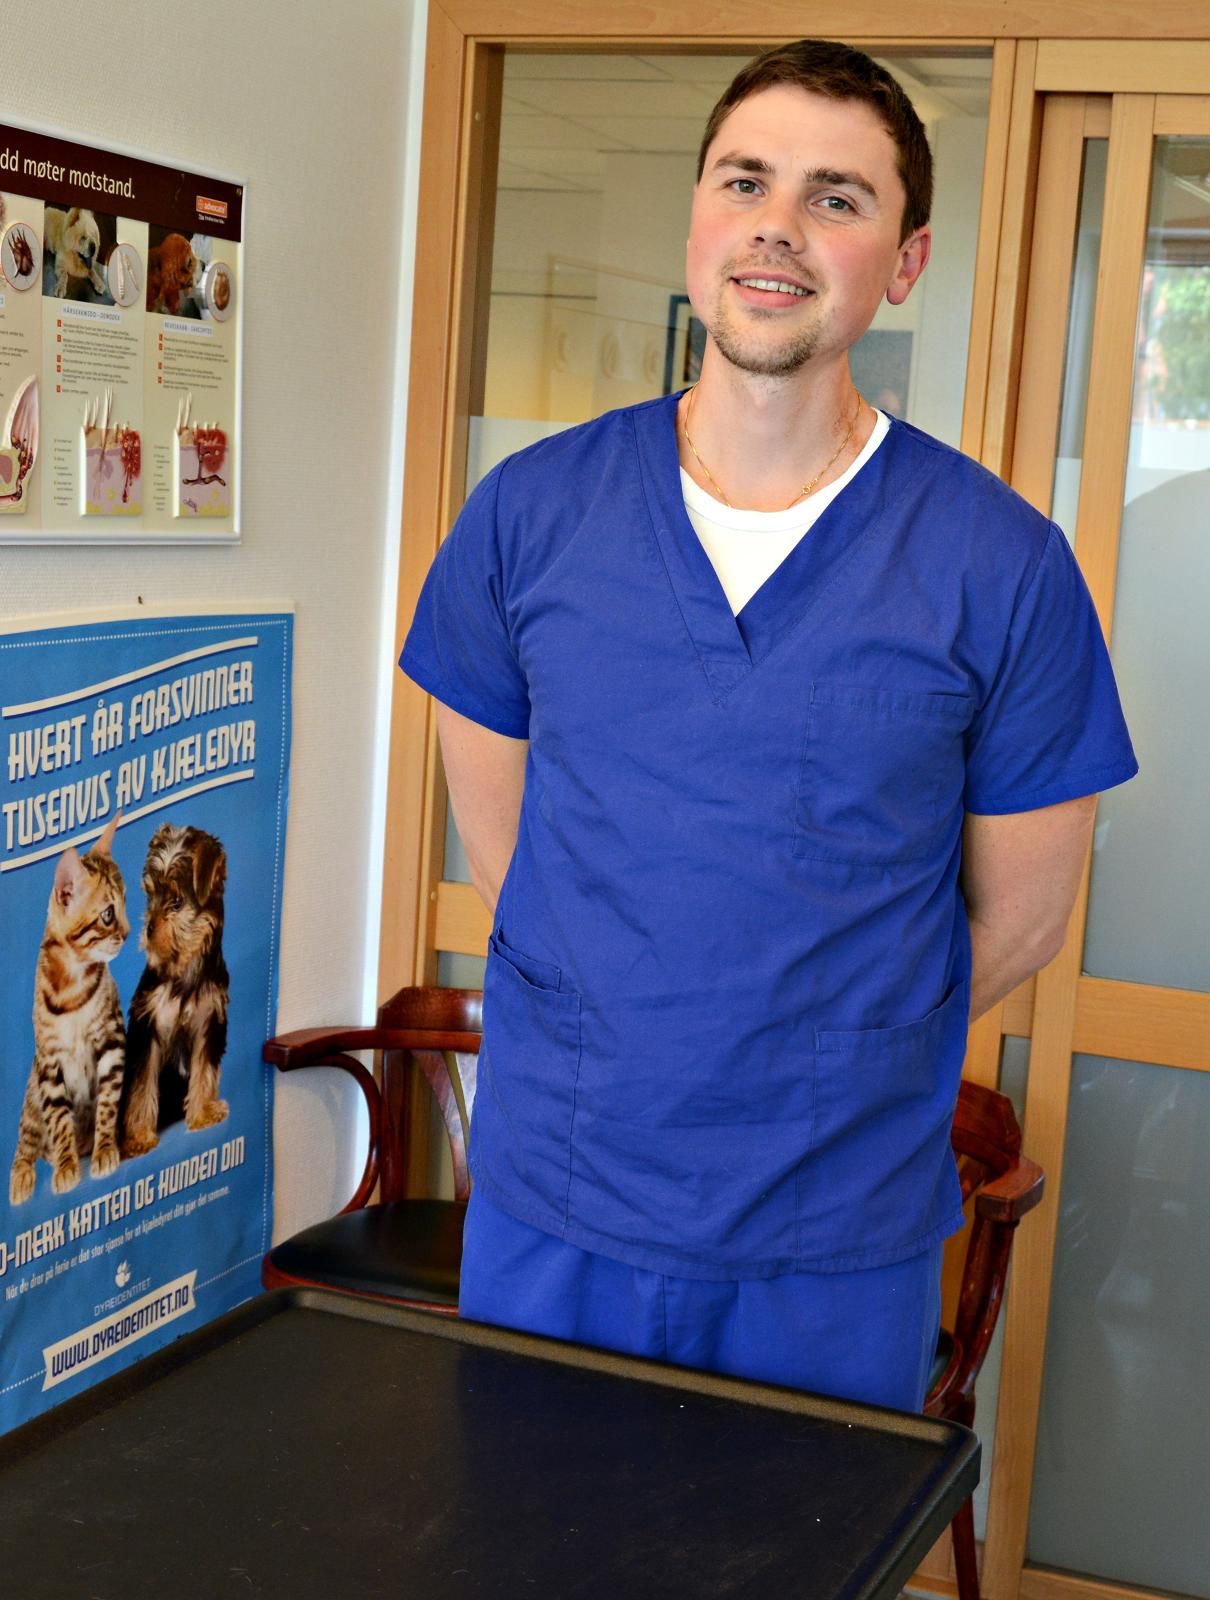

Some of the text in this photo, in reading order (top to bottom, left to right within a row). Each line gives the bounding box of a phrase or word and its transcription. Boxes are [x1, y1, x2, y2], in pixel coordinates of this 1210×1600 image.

[0, 147, 135, 199] dd møter motstand.
[8, 661, 253, 781] HVERT ÅR FORSVINNER
[2, 720, 256, 850] TUSENVIS AV KJÆLEDYR
[68, 1185, 131, 1241] KATTEN
[134, 1174, 155, 1210] OG
[158, 1146, 218, 1199] HUNDEN
[221, 1136, 245, 1172] DIN
[6, 1284, 18, 1300] Når
[20, 1278, 29, 1294] du
[30, 1273, 44, 1288] drar
[45, 1266, 54, 1284] på
[55, 1259, 70, 1276] ferie
[71, 1256, 78, 1267] er
[79, 1248, 90, 1263] det
[91, 1244, 104, 1258] stor
[125, 1227, 134, 1241] for
[134, 1224, 141, 1237] at
[198, 1193, 207, 1207] det
[94, 1277, 151, 1317] DYREIDENTITET
[52, 1285, 189, 1377] WWW.DYREIDENTITET.NO
